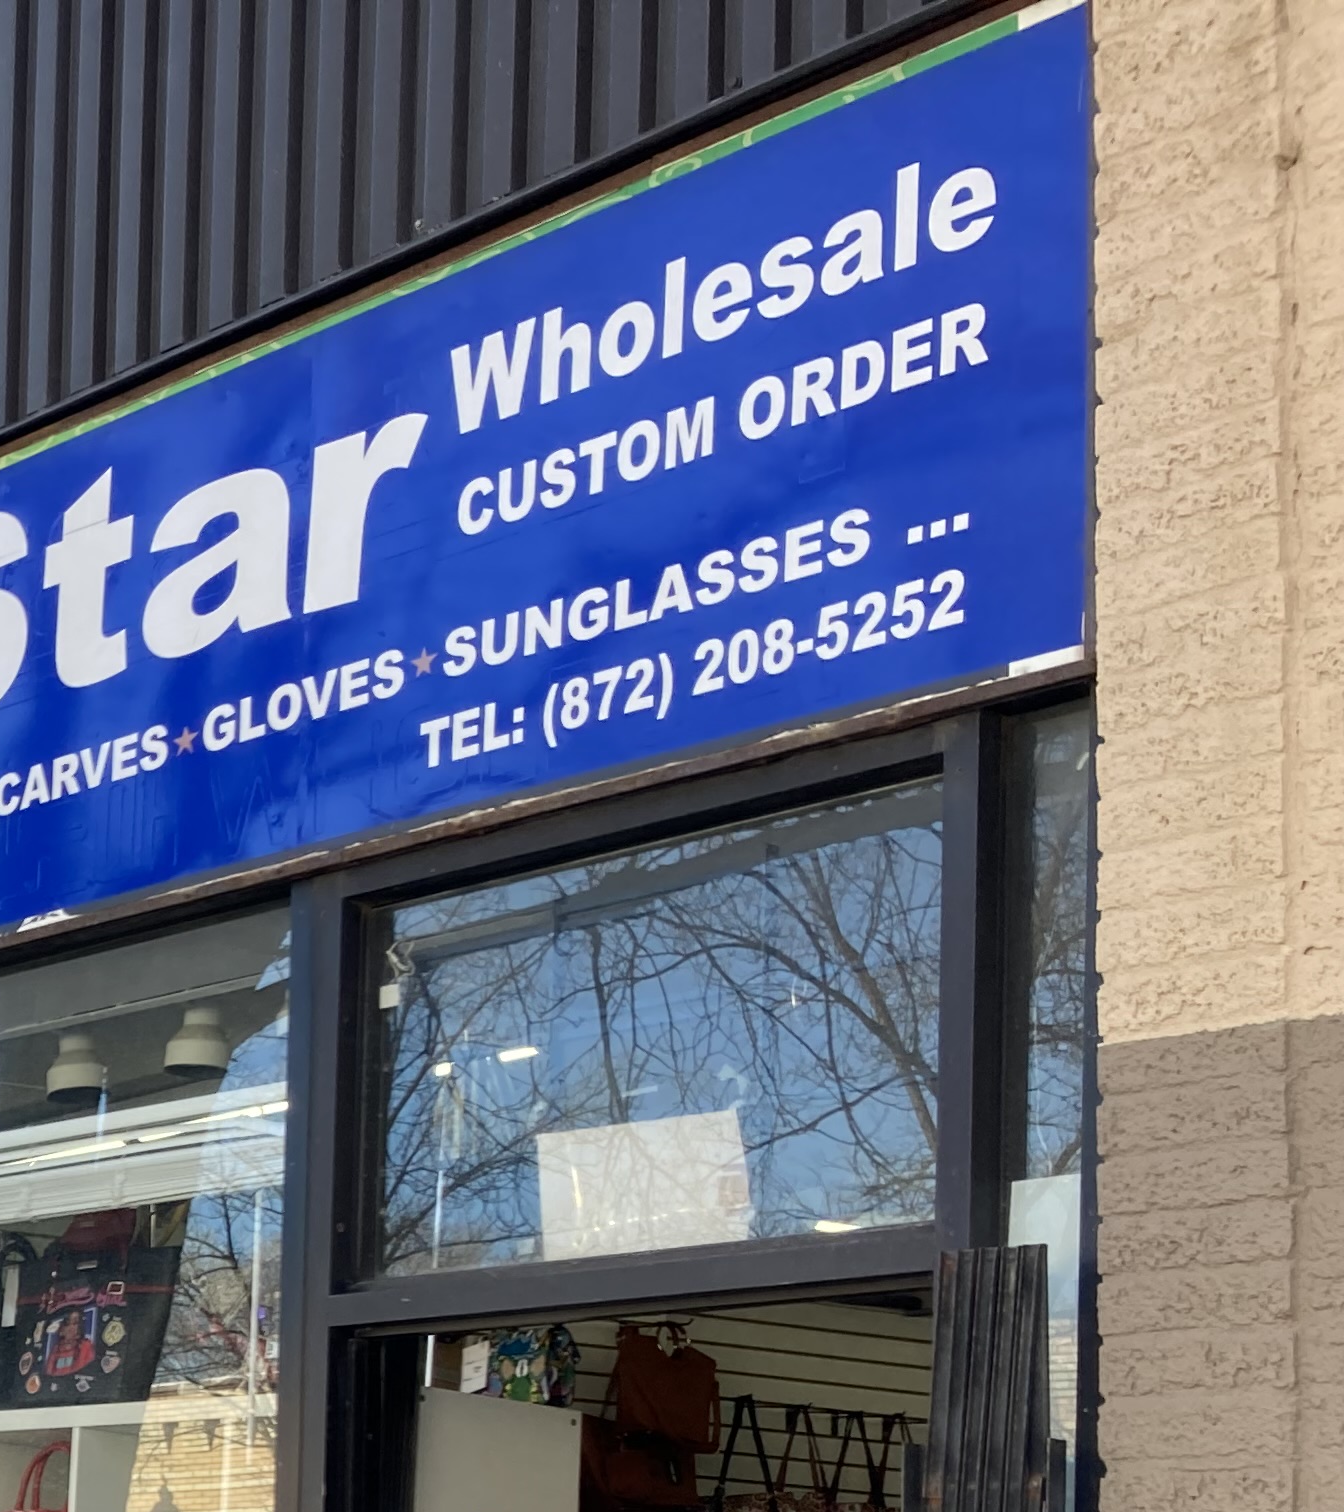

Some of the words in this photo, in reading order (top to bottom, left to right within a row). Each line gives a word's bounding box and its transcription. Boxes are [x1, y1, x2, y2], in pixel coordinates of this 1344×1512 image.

[450, 161, 999, 436] Wholesale
[456, 394, 715, 537] CUSTOM
[738, 302, 990, 443] ORDER
[200, 648, 406, 755] GLOVES
[441, 507, 872, 679] SUNGLASSES
[419, 702, 526, 770] TEL:
[542, 650, 674, 749] (872)
[692, 568, 967, 699] 208-5252
